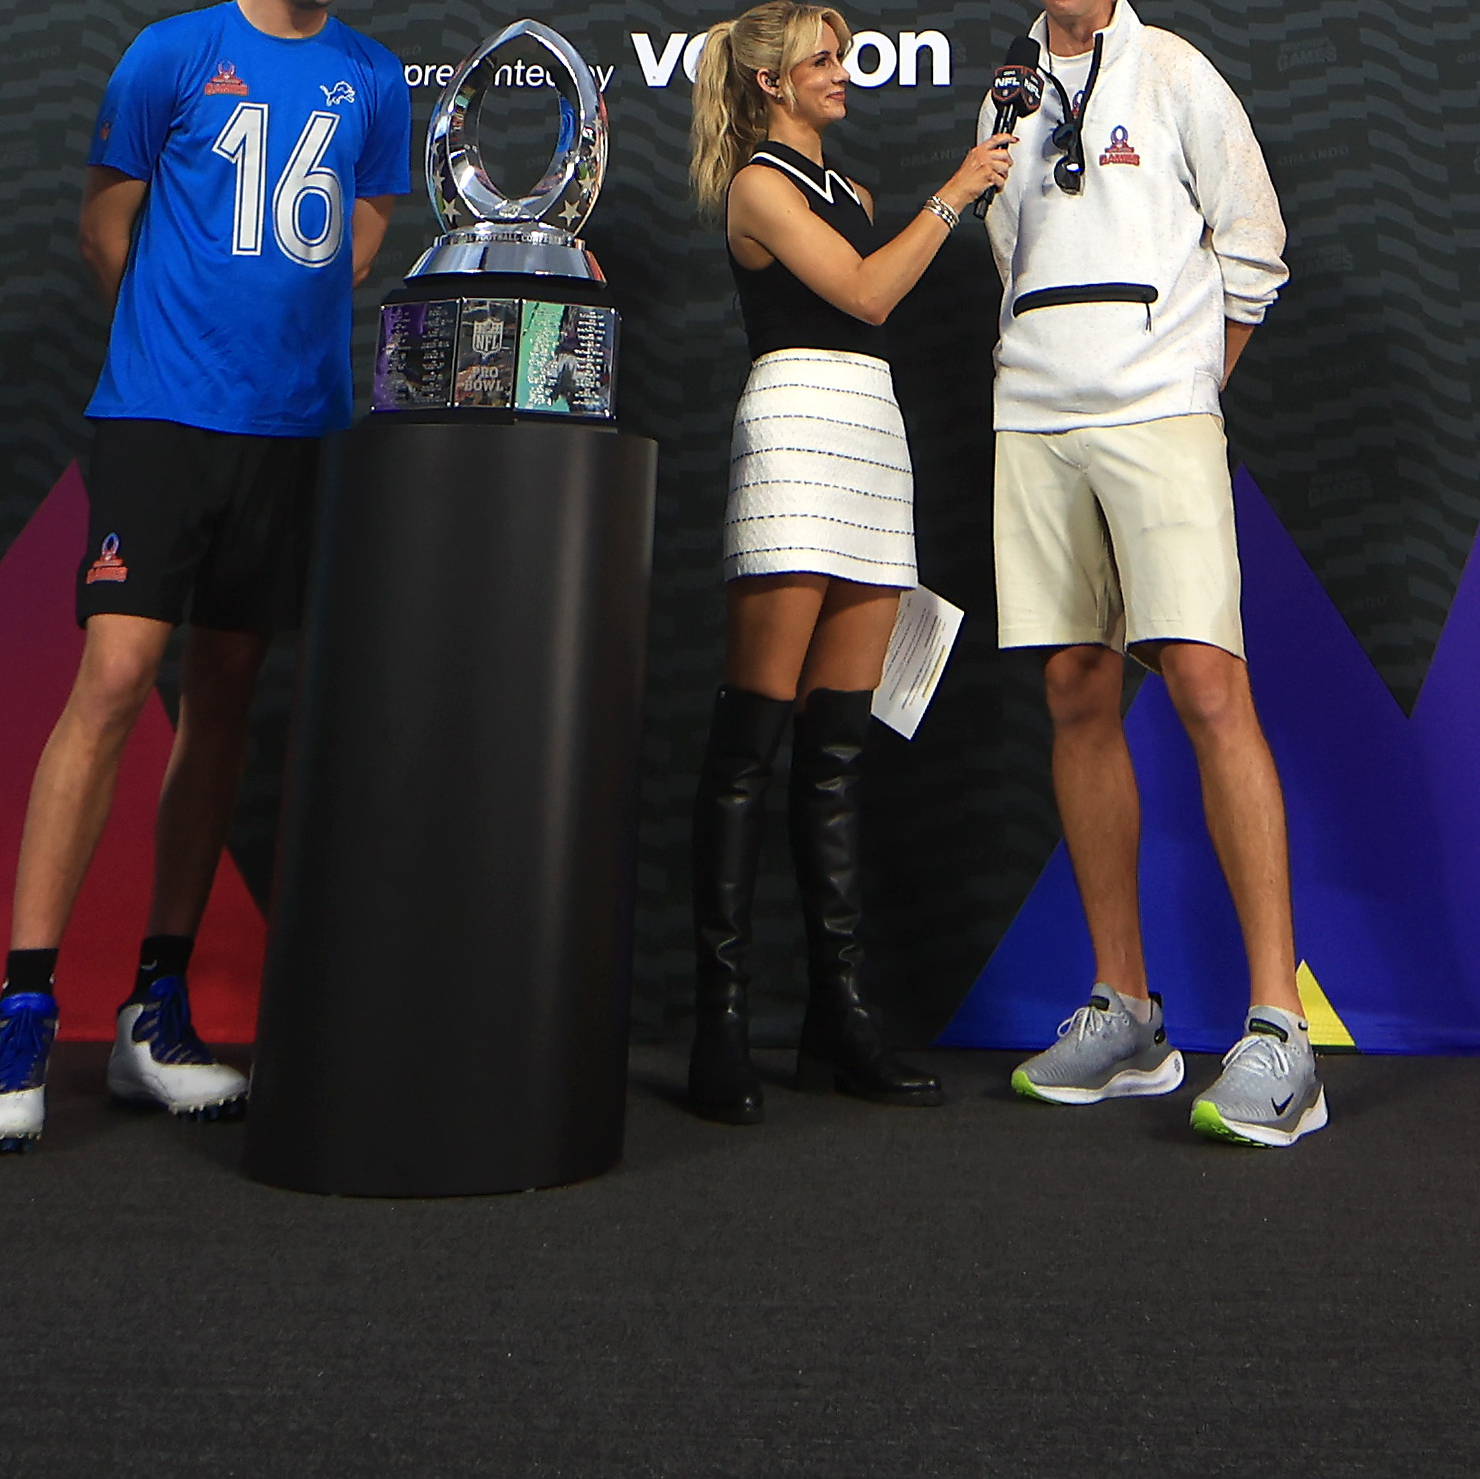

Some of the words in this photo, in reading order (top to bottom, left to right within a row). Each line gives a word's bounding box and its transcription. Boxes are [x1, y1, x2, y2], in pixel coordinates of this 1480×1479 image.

[404, 59, 556, 86] prente
[994, 77, 1020, 88] NFL
[211, 102, 344, 268] 16
[475, 334, 500, 353] NFL
[471, 367, 499, 379] PRO
[464, 378, 503, 392] BOWL
